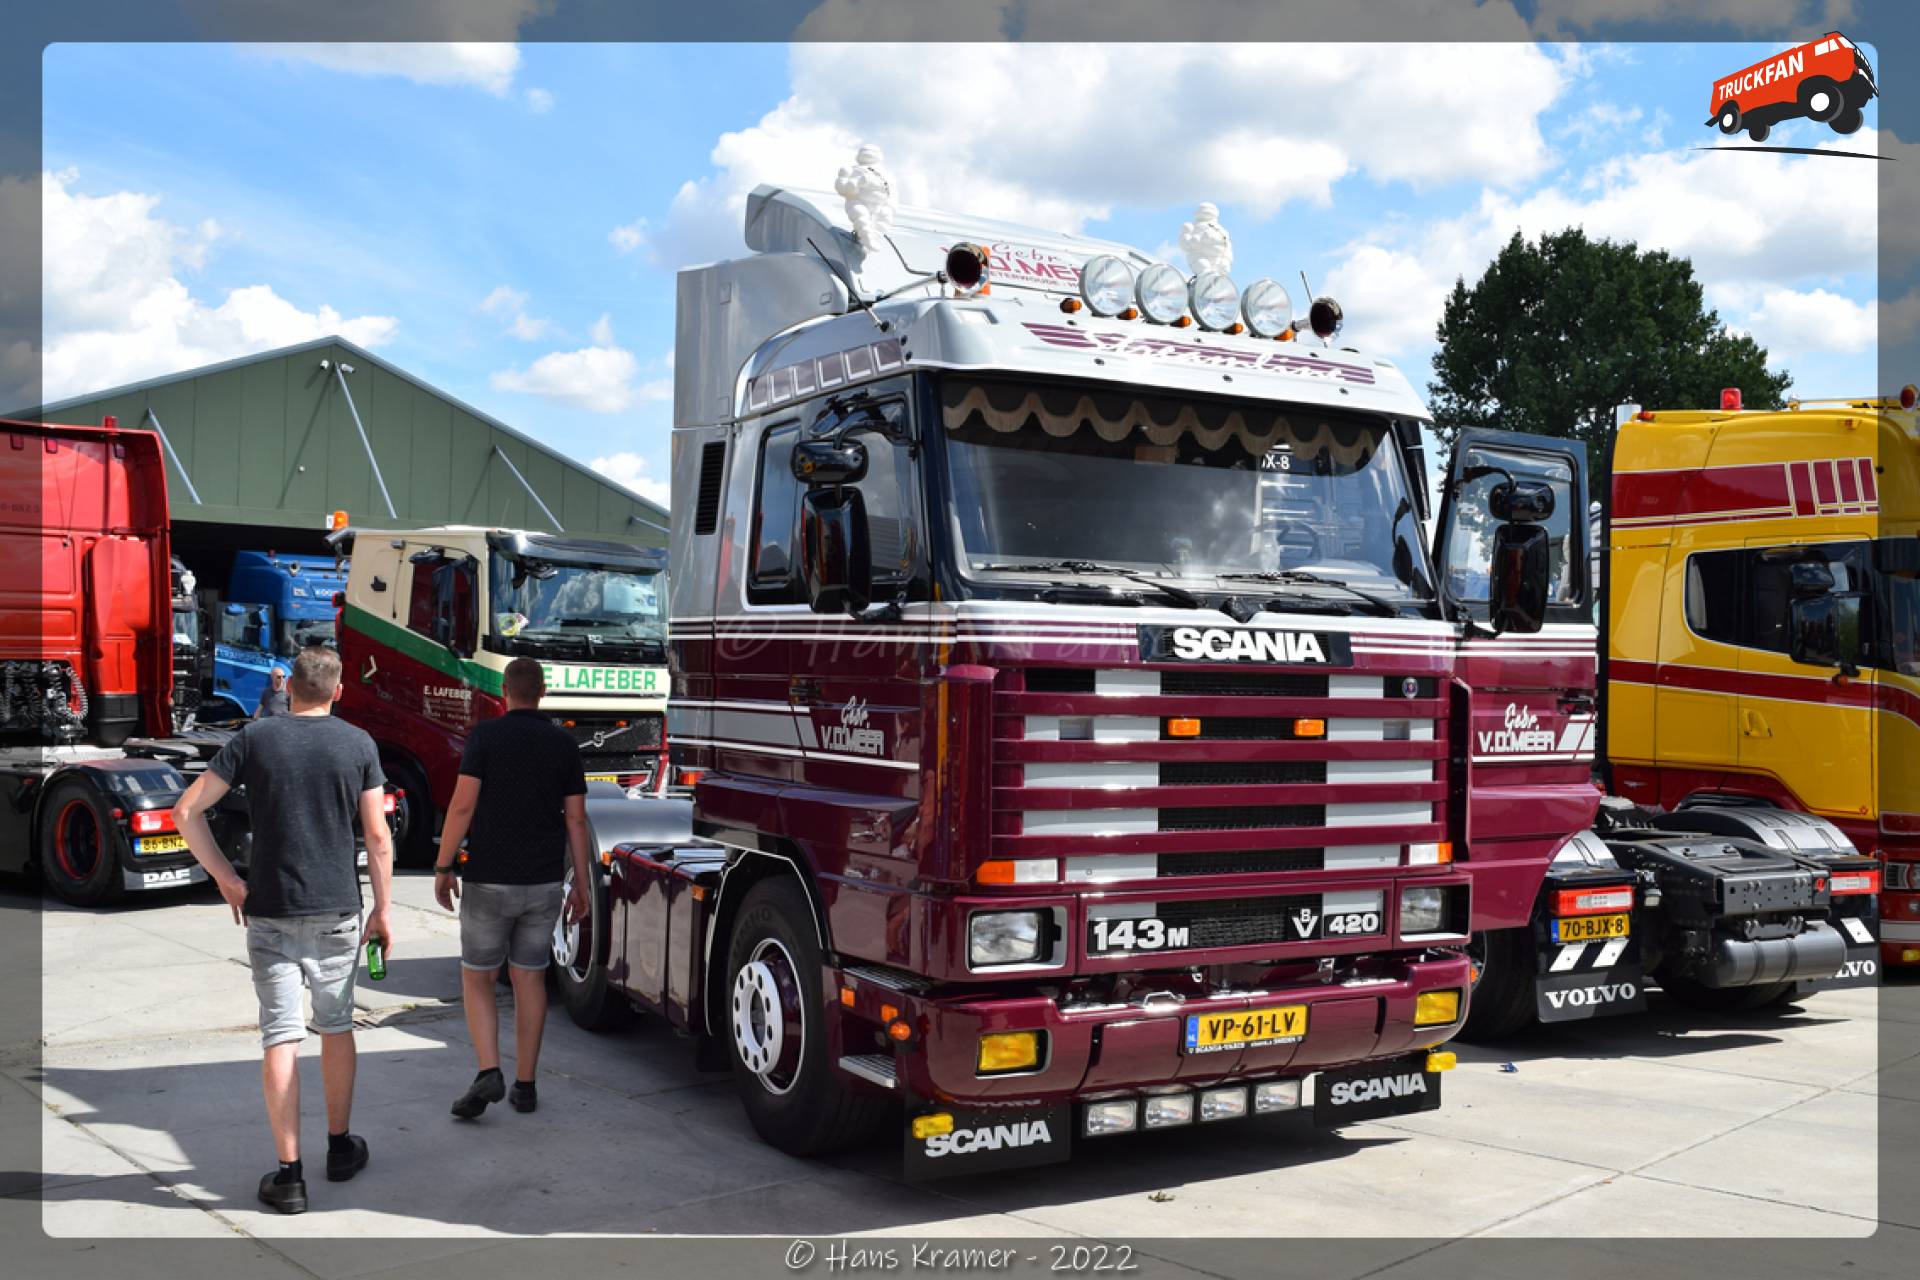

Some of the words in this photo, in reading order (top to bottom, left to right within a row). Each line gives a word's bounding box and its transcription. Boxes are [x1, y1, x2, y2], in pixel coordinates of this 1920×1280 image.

[1173, 627, 1326, 662] SCANIA
[564, 668, 657, 690] LAFEBER
[143, 868, 191, 889] DAF
[1329, 913, 1379, 934] 420
[1563, 918, 1624, 938] 70-BJX-8
[1545, 982, 1636, 1009] VOLVO
[1208, 1011, 1296, 1041] VP-61-LV
[1330, 1072, 1427, 1105] SCANIA
[925, 1120, 1052, 1158] SCANIA
